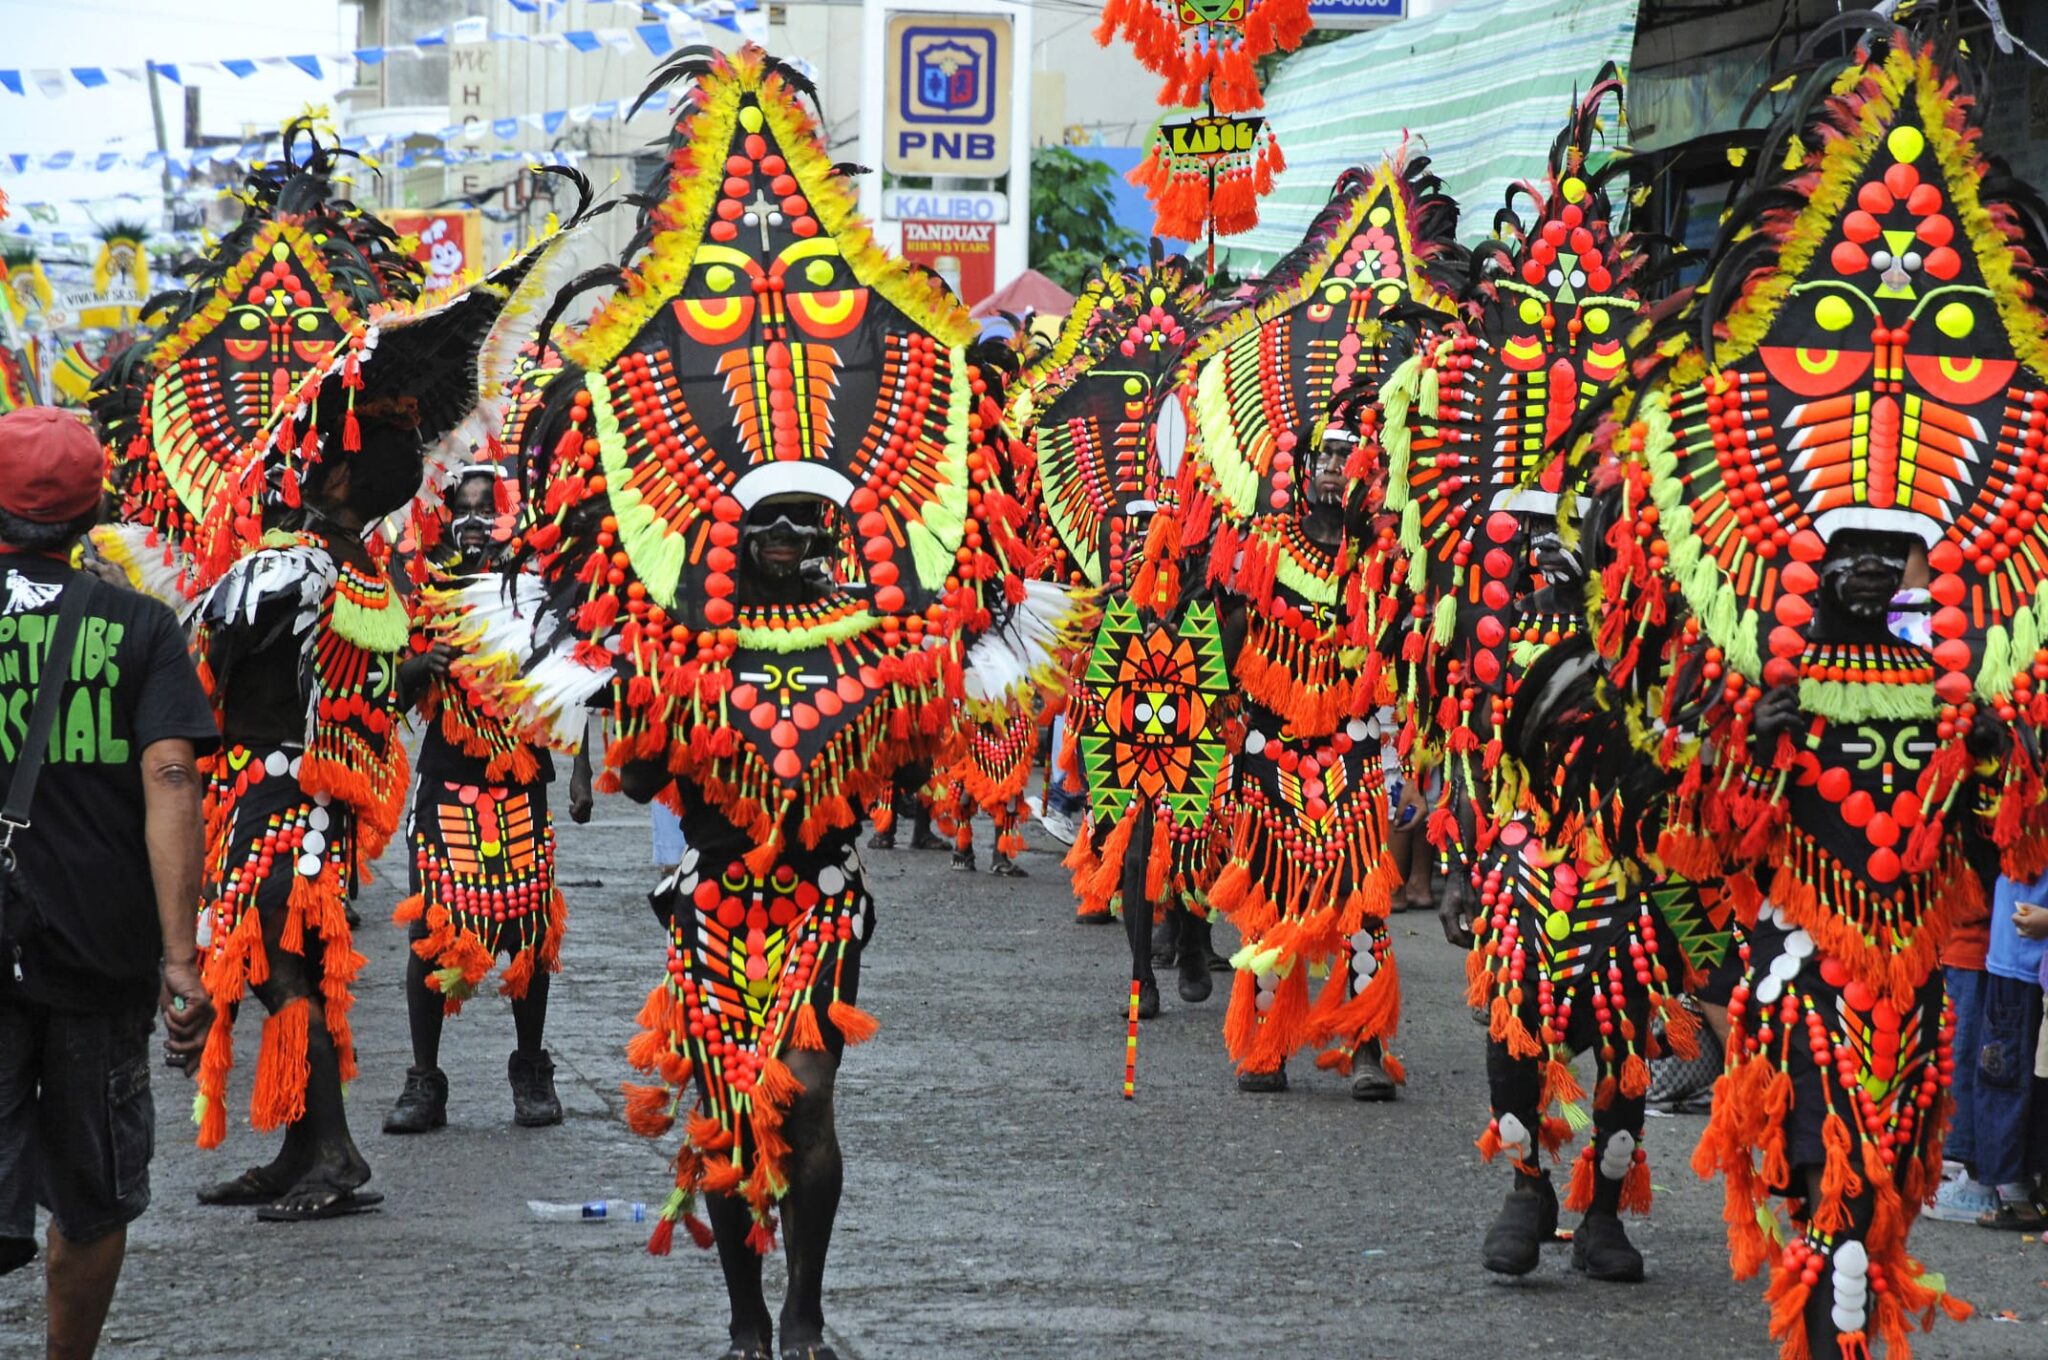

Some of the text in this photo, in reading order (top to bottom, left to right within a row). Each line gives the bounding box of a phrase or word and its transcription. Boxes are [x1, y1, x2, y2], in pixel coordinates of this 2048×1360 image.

[898, 131, 996, 160] PNB
[1173, 122, 1253, 154] KABOG
[895, 195, 994, 221] KALIBO
[904, 223, 993, 242] TANDUAY
[907, 241, 941, 251] RHUM
[953, 241, 990, 253] YEARS
[1131, 681, 1185, 694] KABOG
[1136, 733, 1173, 744] 2010
